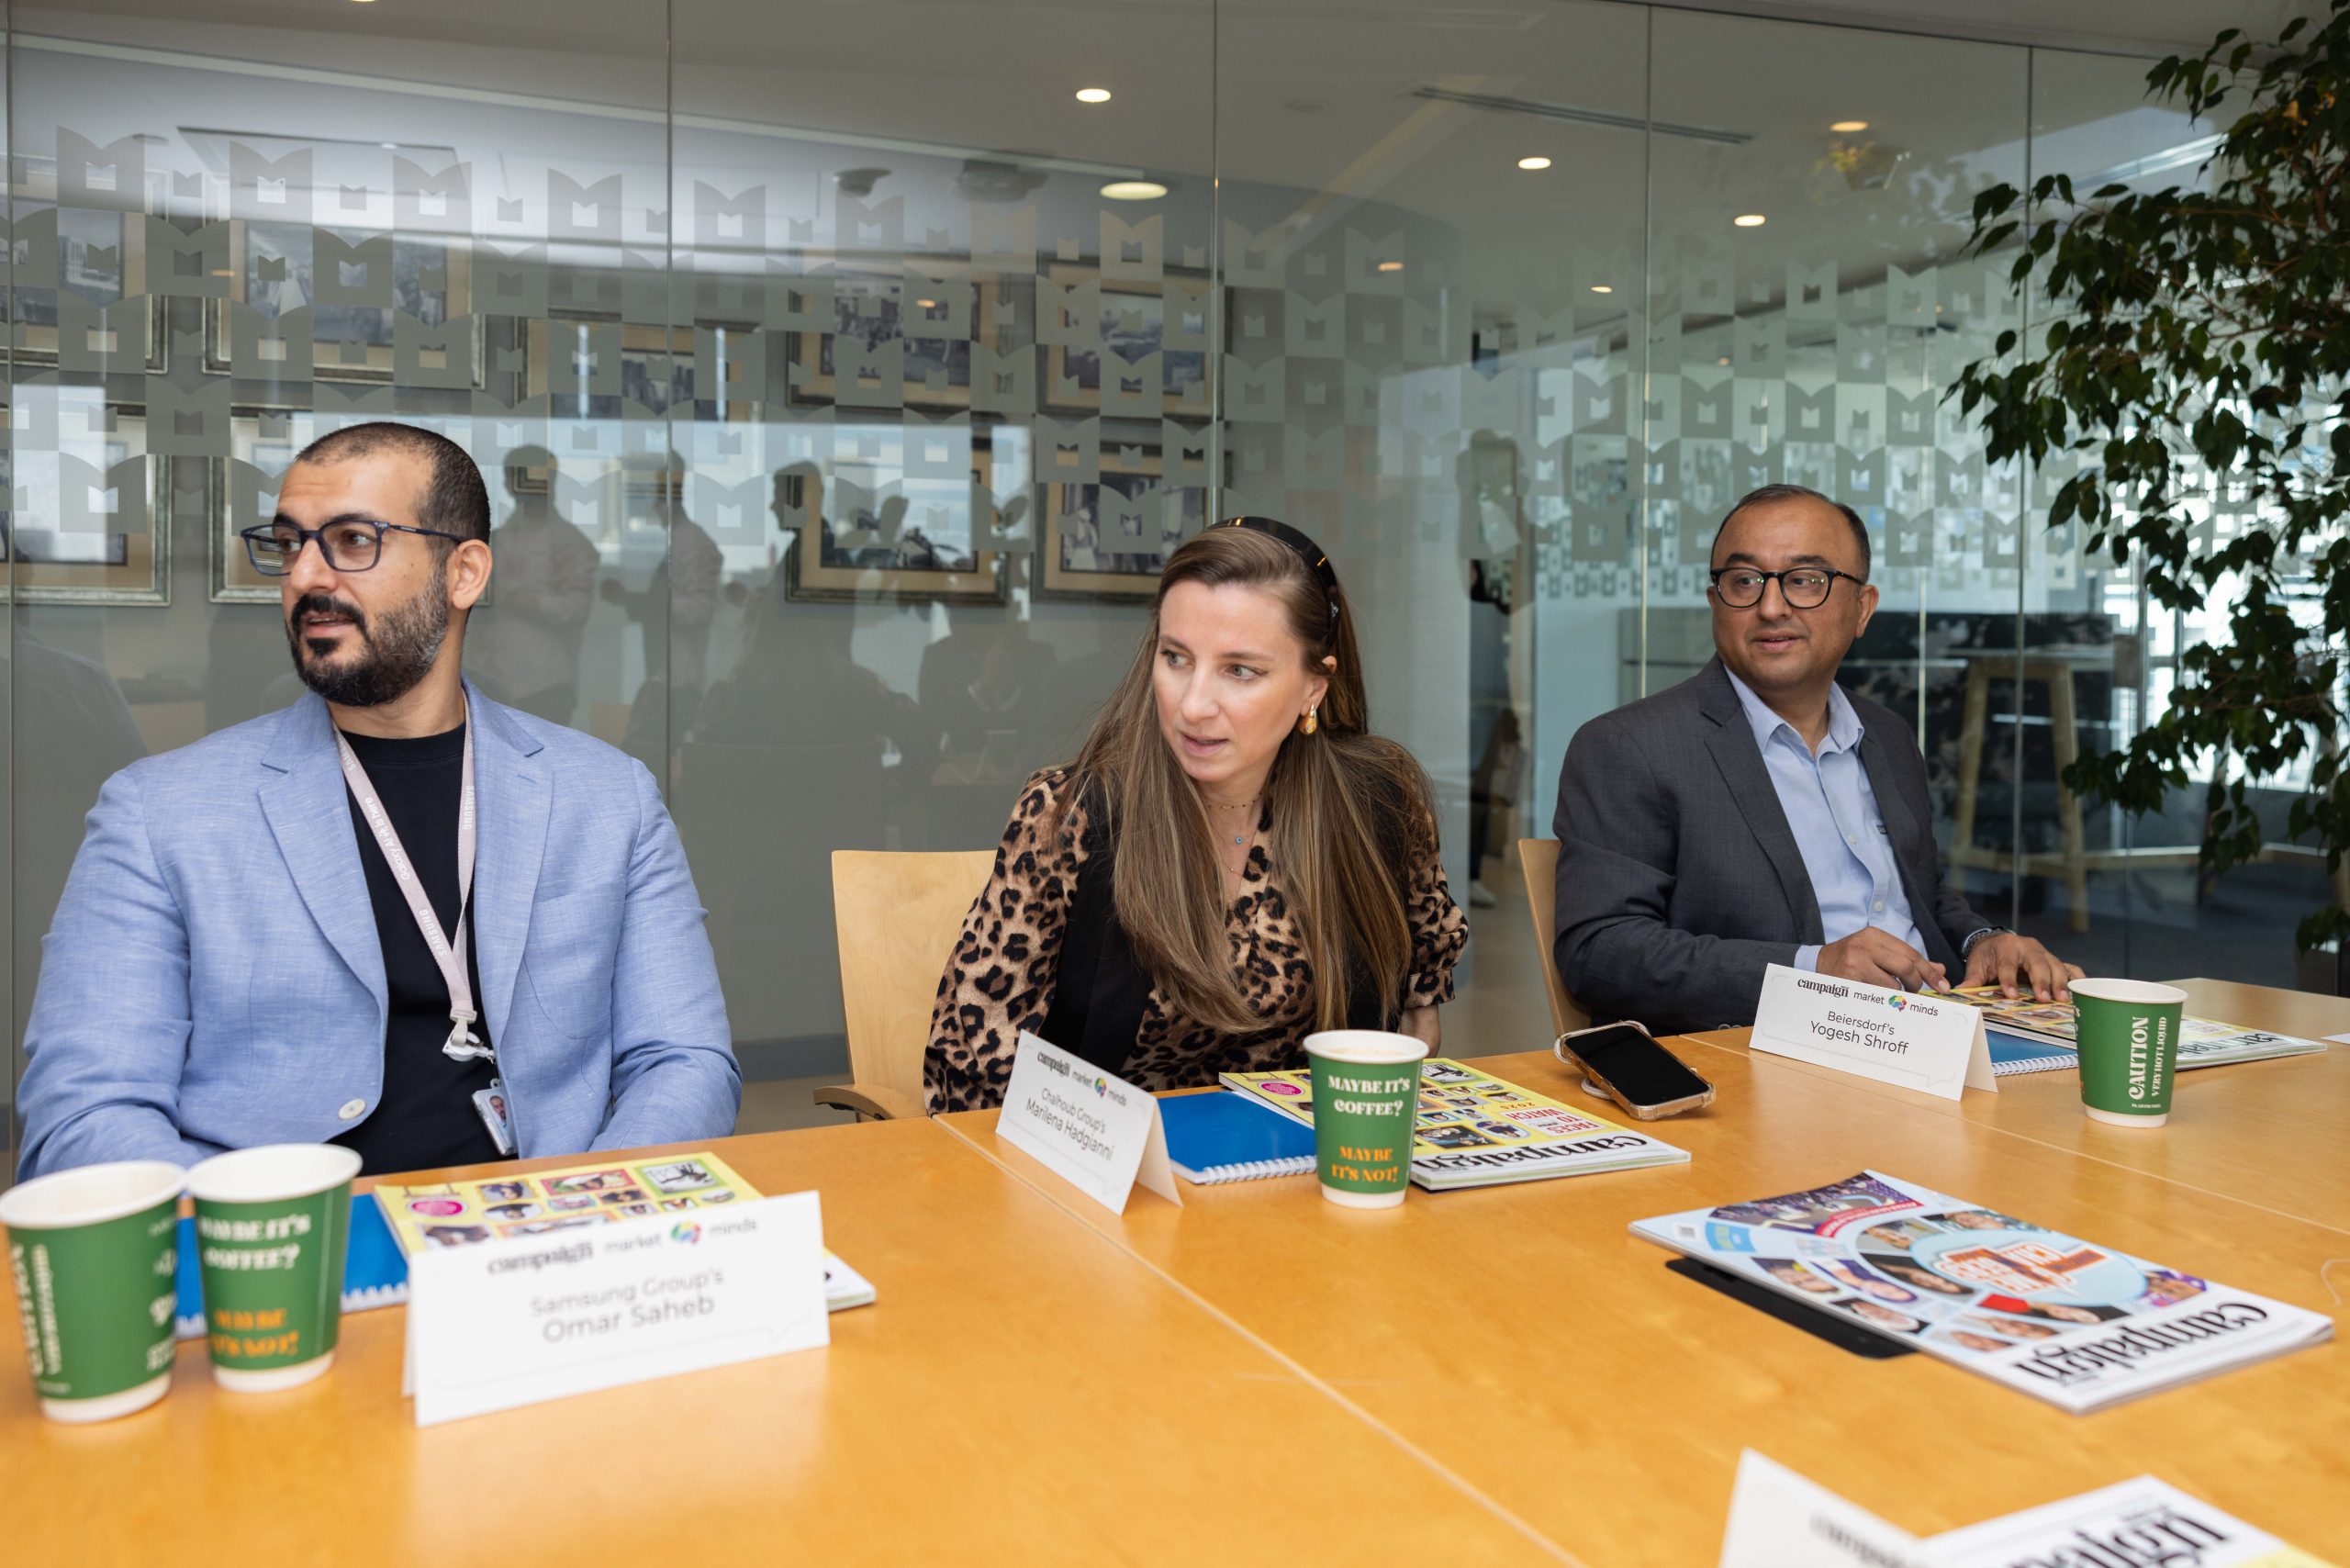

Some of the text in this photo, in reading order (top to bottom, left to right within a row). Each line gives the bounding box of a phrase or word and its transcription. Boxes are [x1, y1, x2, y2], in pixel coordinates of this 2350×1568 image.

[365, 796, 380, 820] here
[464, 785, 475, 830] SAMSUNG
[390, 847, 410, 880] Galaxy
[419, 909, 447, 956] SAMSUNG
[1796, 978, 1939, 1016] campaign market minds
[1810, 1020, 1909, 1055] Yogesh Shroff
[1827, 1011, 1895, 1035] Beiersdorf's
[2129, 1016, 2149, 1100] CAUTION
[2154, 1050, 2165, 1072] HOT
[1072, 1070, 1092, 1089] market
[1107, 1089, 1127, 1106] minds
[1327, 1075, 1411, 1093] MAYBE IT'S
[2152, 1072, 2162, 1097] VERY
[1041, 1087, 1106, 1134] Chalhoub Group's
[1334, 1099, 1404, 1116] COFFEE?
[1505, 1109, 1564, 1120] WATCH
[1025, 1097, 1114, 1161] Marilena Hadgianni
[1548, 1122, 1599, 1133] FACES
[1339, 1145, 1393, 1161] MAYBE
[1331, 1163, 1399, 1183] IT'S NOT!
[487, 1217, 757, 1275] campaign market minds
[529, 1267, 724, 1317] Samsung Group's
[542, 1294, 716, 1344] Omar Saheb
[2010, 1303, 2268, 1379] campaign
